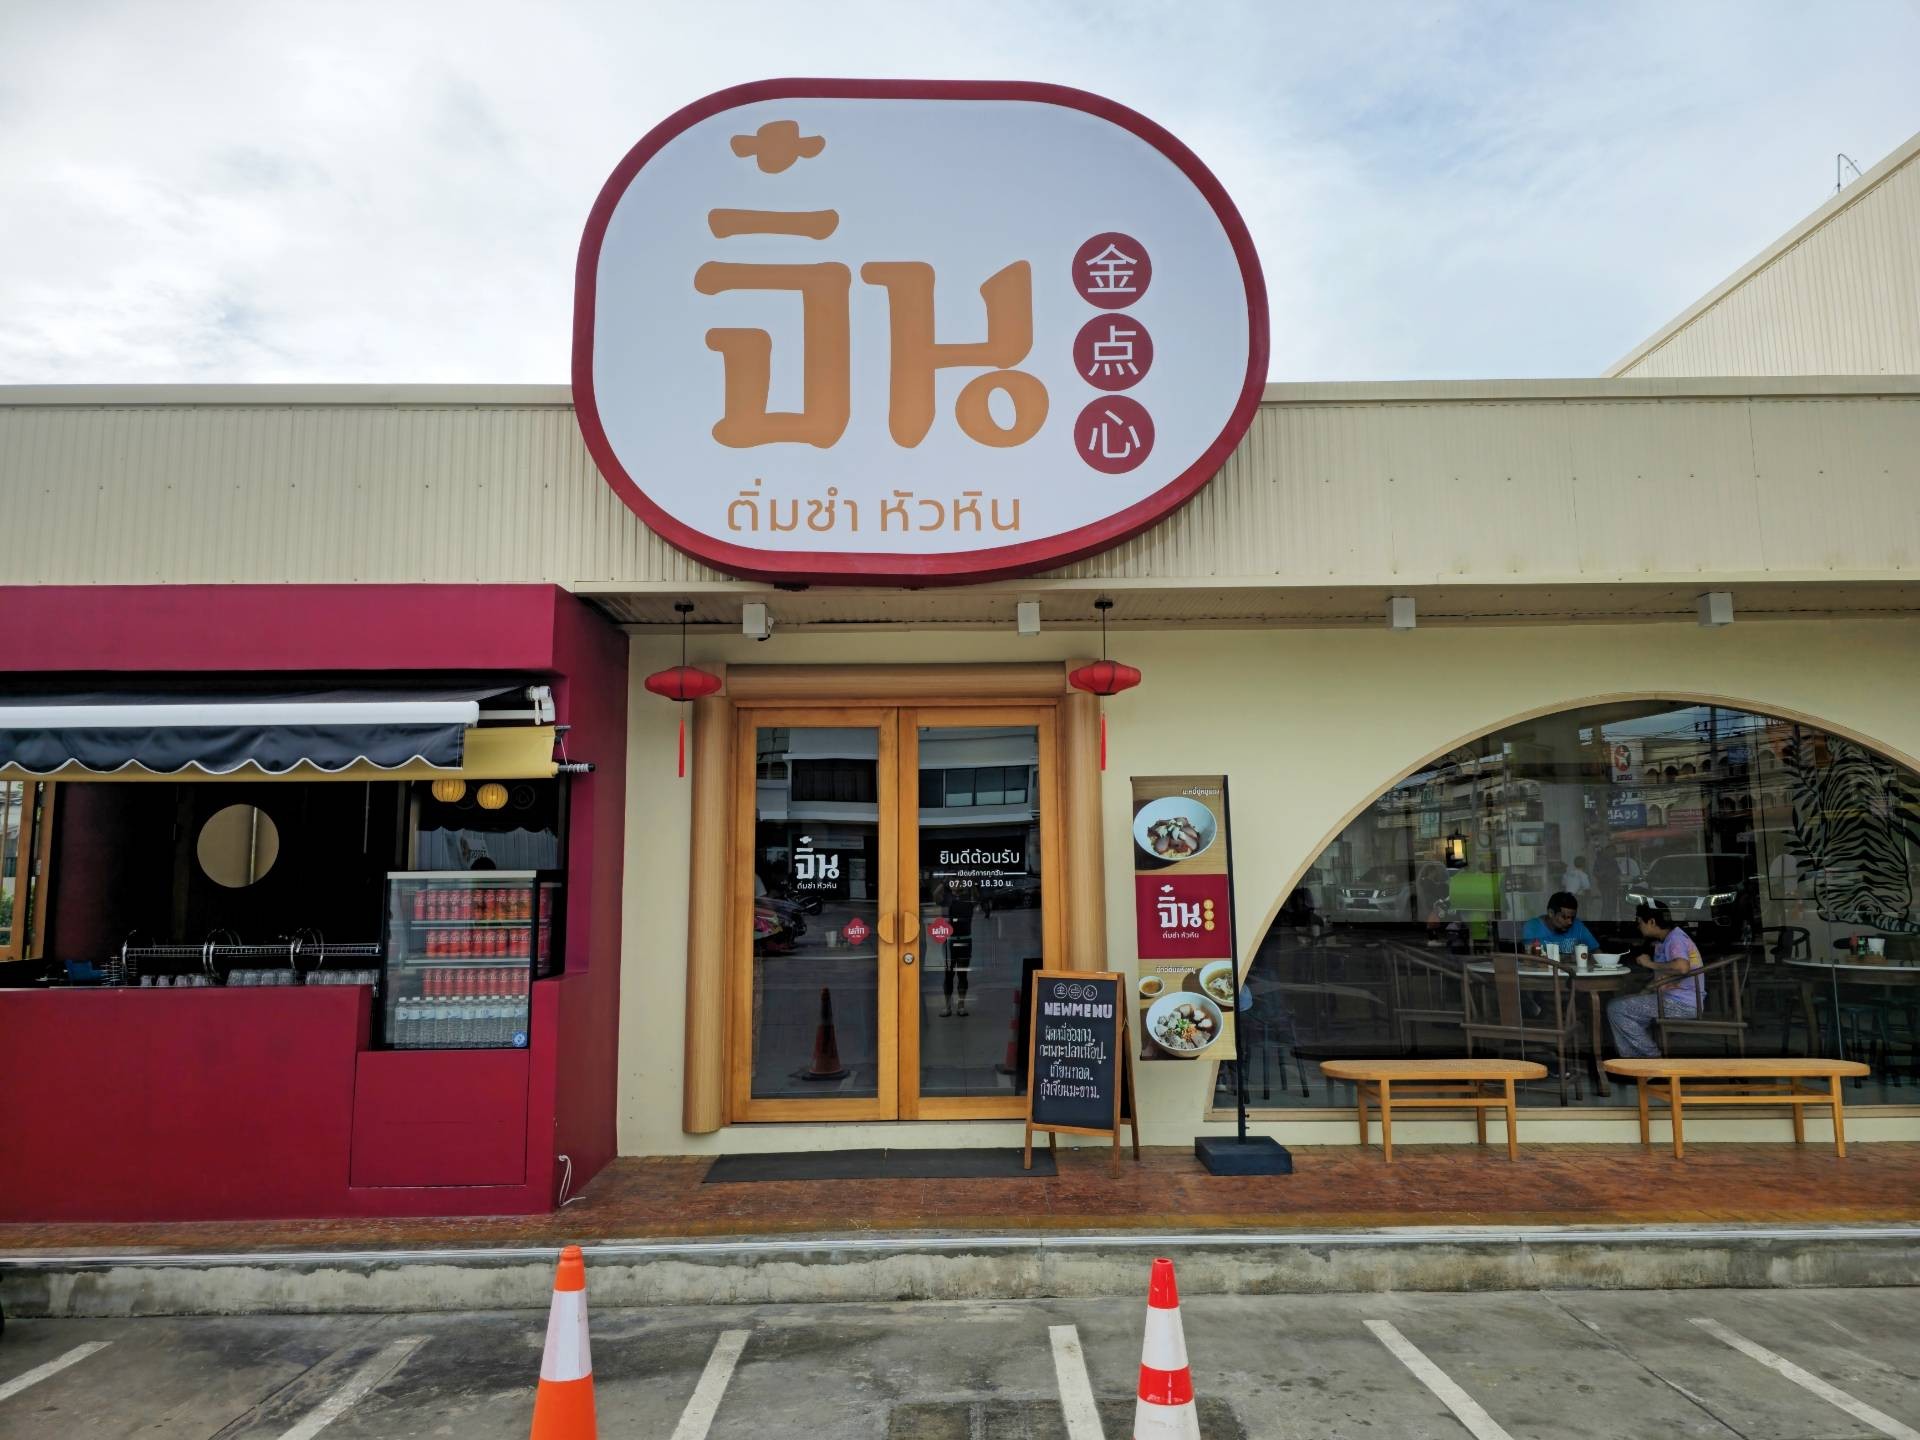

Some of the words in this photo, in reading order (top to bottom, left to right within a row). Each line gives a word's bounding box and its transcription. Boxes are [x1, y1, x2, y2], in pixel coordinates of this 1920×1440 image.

[1086, 243, 1140, 460] 金点心
[727, 479, 858, 532] ติ่มซำ
[880, 491, 1020, 532] หัวหิน
[940, 848, 1020, 865] ยินดีต้อนรับ
[948, 879, 973, 888] 07.30
[980, 879, 1004, 888] 18.30
